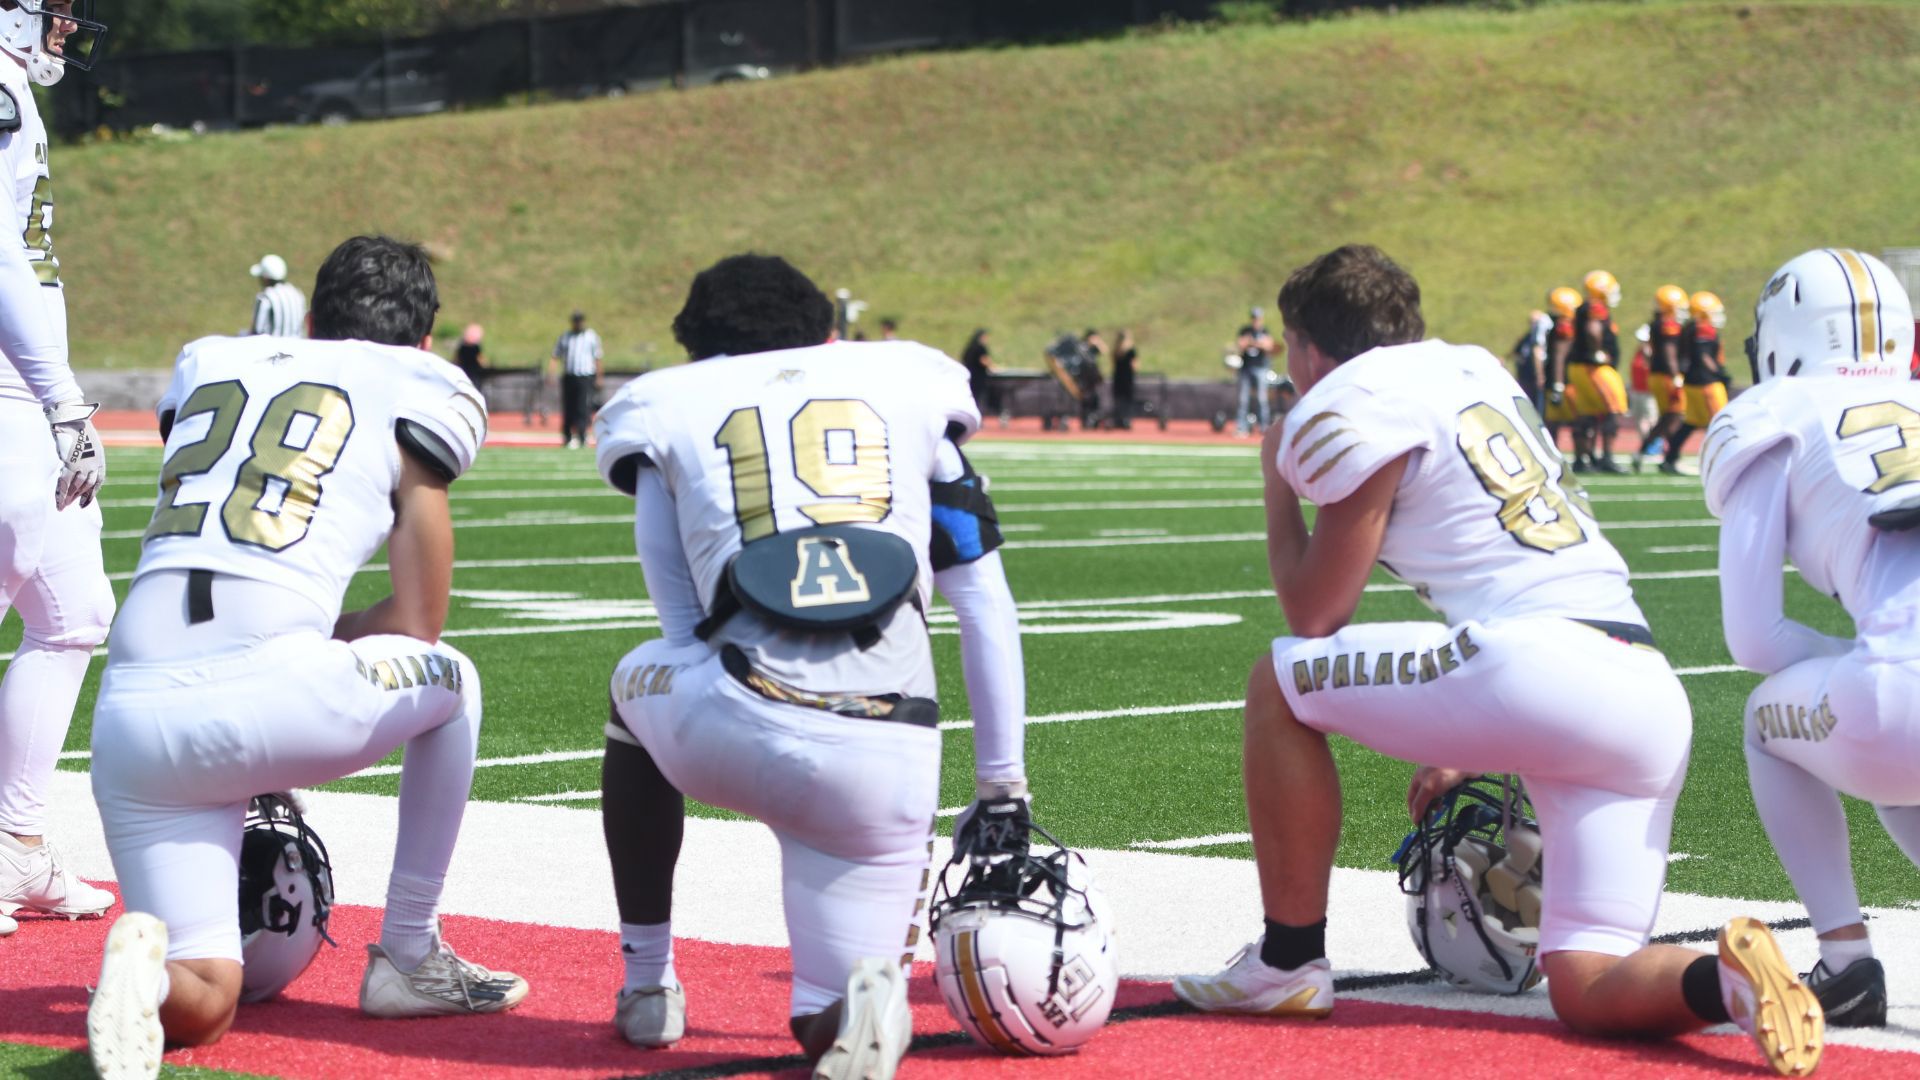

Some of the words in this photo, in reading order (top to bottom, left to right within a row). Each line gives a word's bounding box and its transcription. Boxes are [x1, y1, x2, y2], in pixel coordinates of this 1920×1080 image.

[70, 428, 86, 463] adidas
[145, 378, 355, 554] 28
[714, 398, 893, 547] 19
[790, 537, 871, 608] A
[1293, 626, 1481, 696] APALACHEE
[1036, 1001, 1068, 1029] EAT
